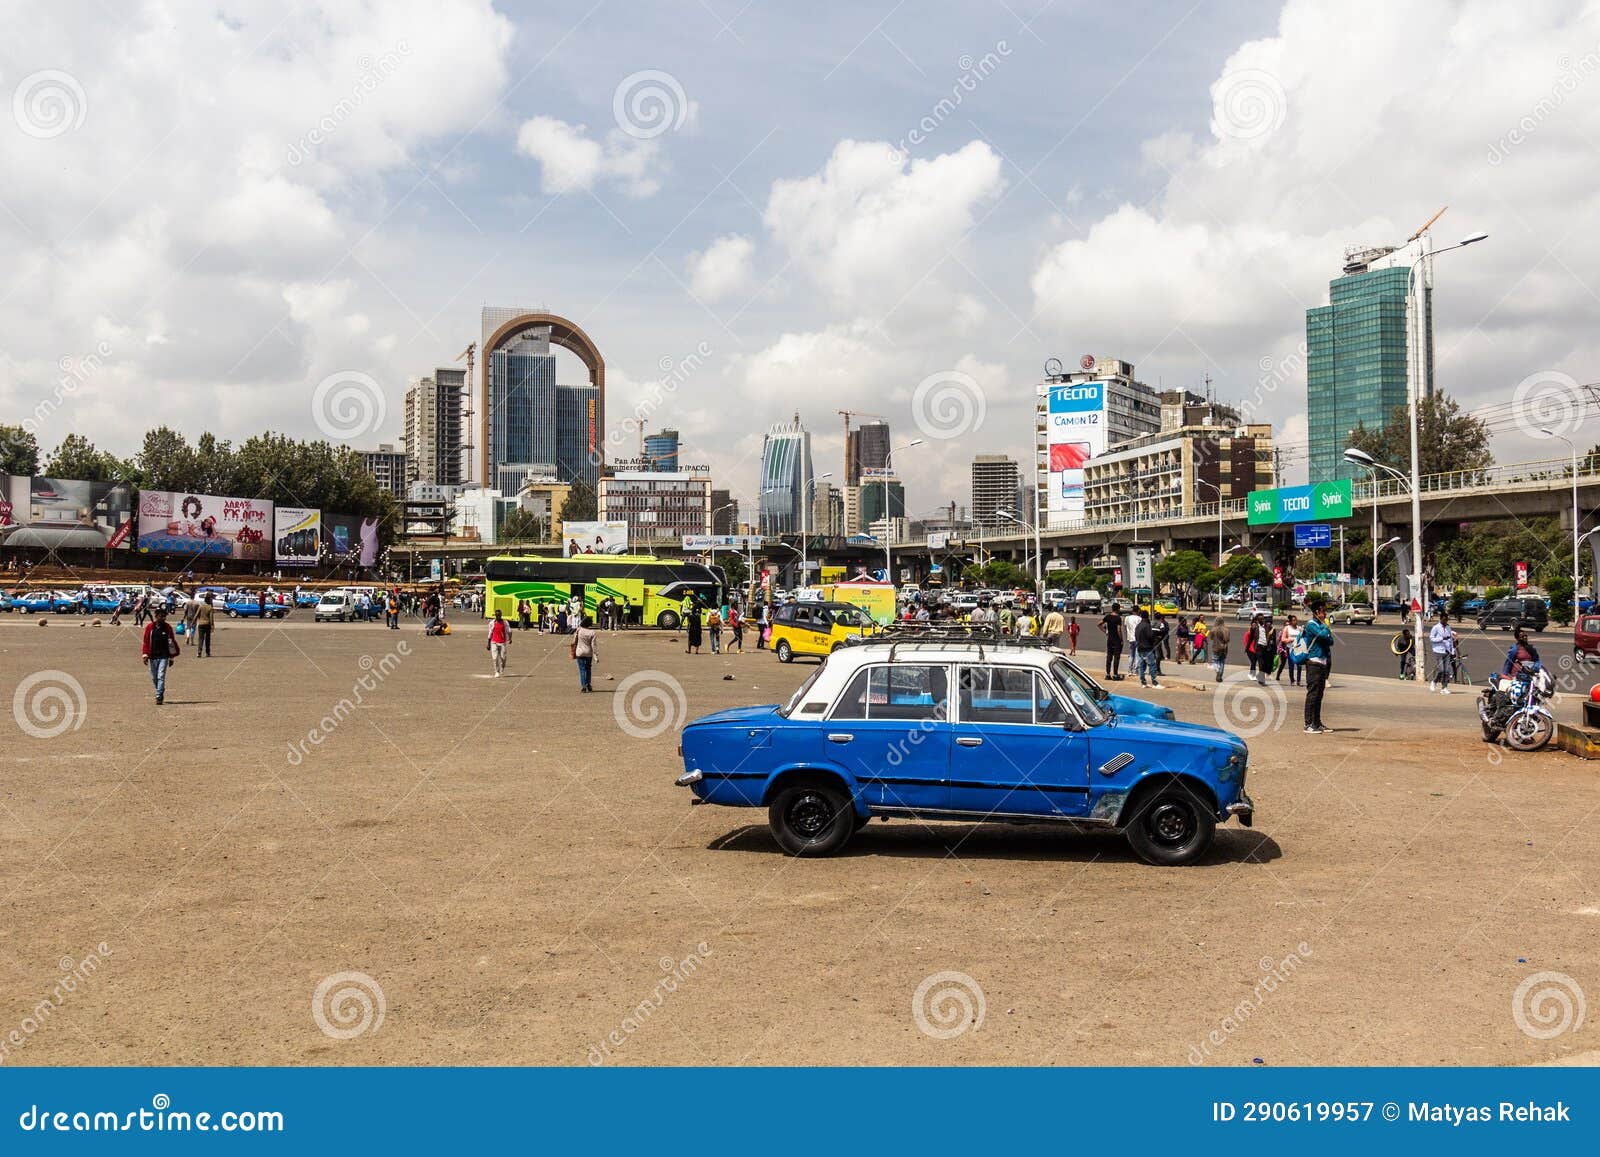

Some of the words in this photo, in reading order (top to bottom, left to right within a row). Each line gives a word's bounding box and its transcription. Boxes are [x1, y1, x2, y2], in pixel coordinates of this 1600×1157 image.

[1056, 387, 1098, 401] TECNO
[1054, 416, 1087, 426] CAMON
[1088, 413, 1099, 425] 12
[614, 457, 628, 465] Pan
[1283, 496, 1310, 511] TECNO
[1322, 491, 1343, 508] Syinix
[1254, 500, 1271, 514] Syinix
